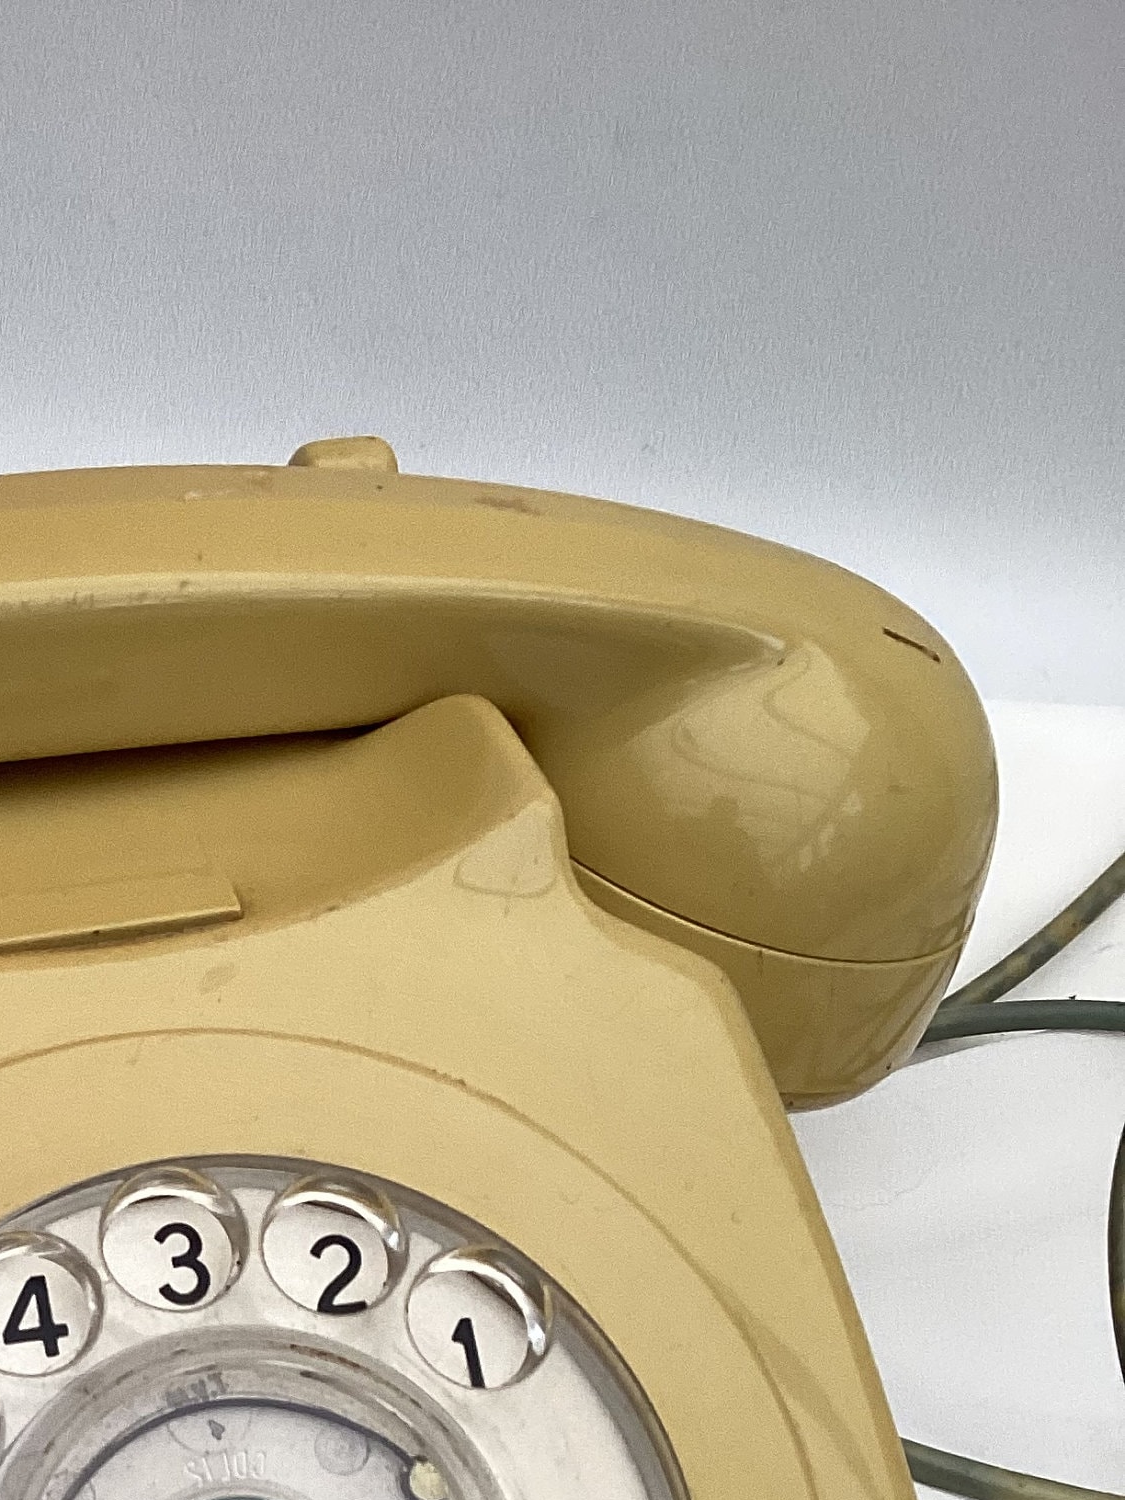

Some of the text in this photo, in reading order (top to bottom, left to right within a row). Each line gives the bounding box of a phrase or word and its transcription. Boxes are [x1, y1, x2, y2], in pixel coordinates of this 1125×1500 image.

[154, 1222, 211, 1306] 3
[310, 1234, 368, 1315] 2
[2, 1275, 69, 1358] 4
[451, 1317, 486, 1389] 1
